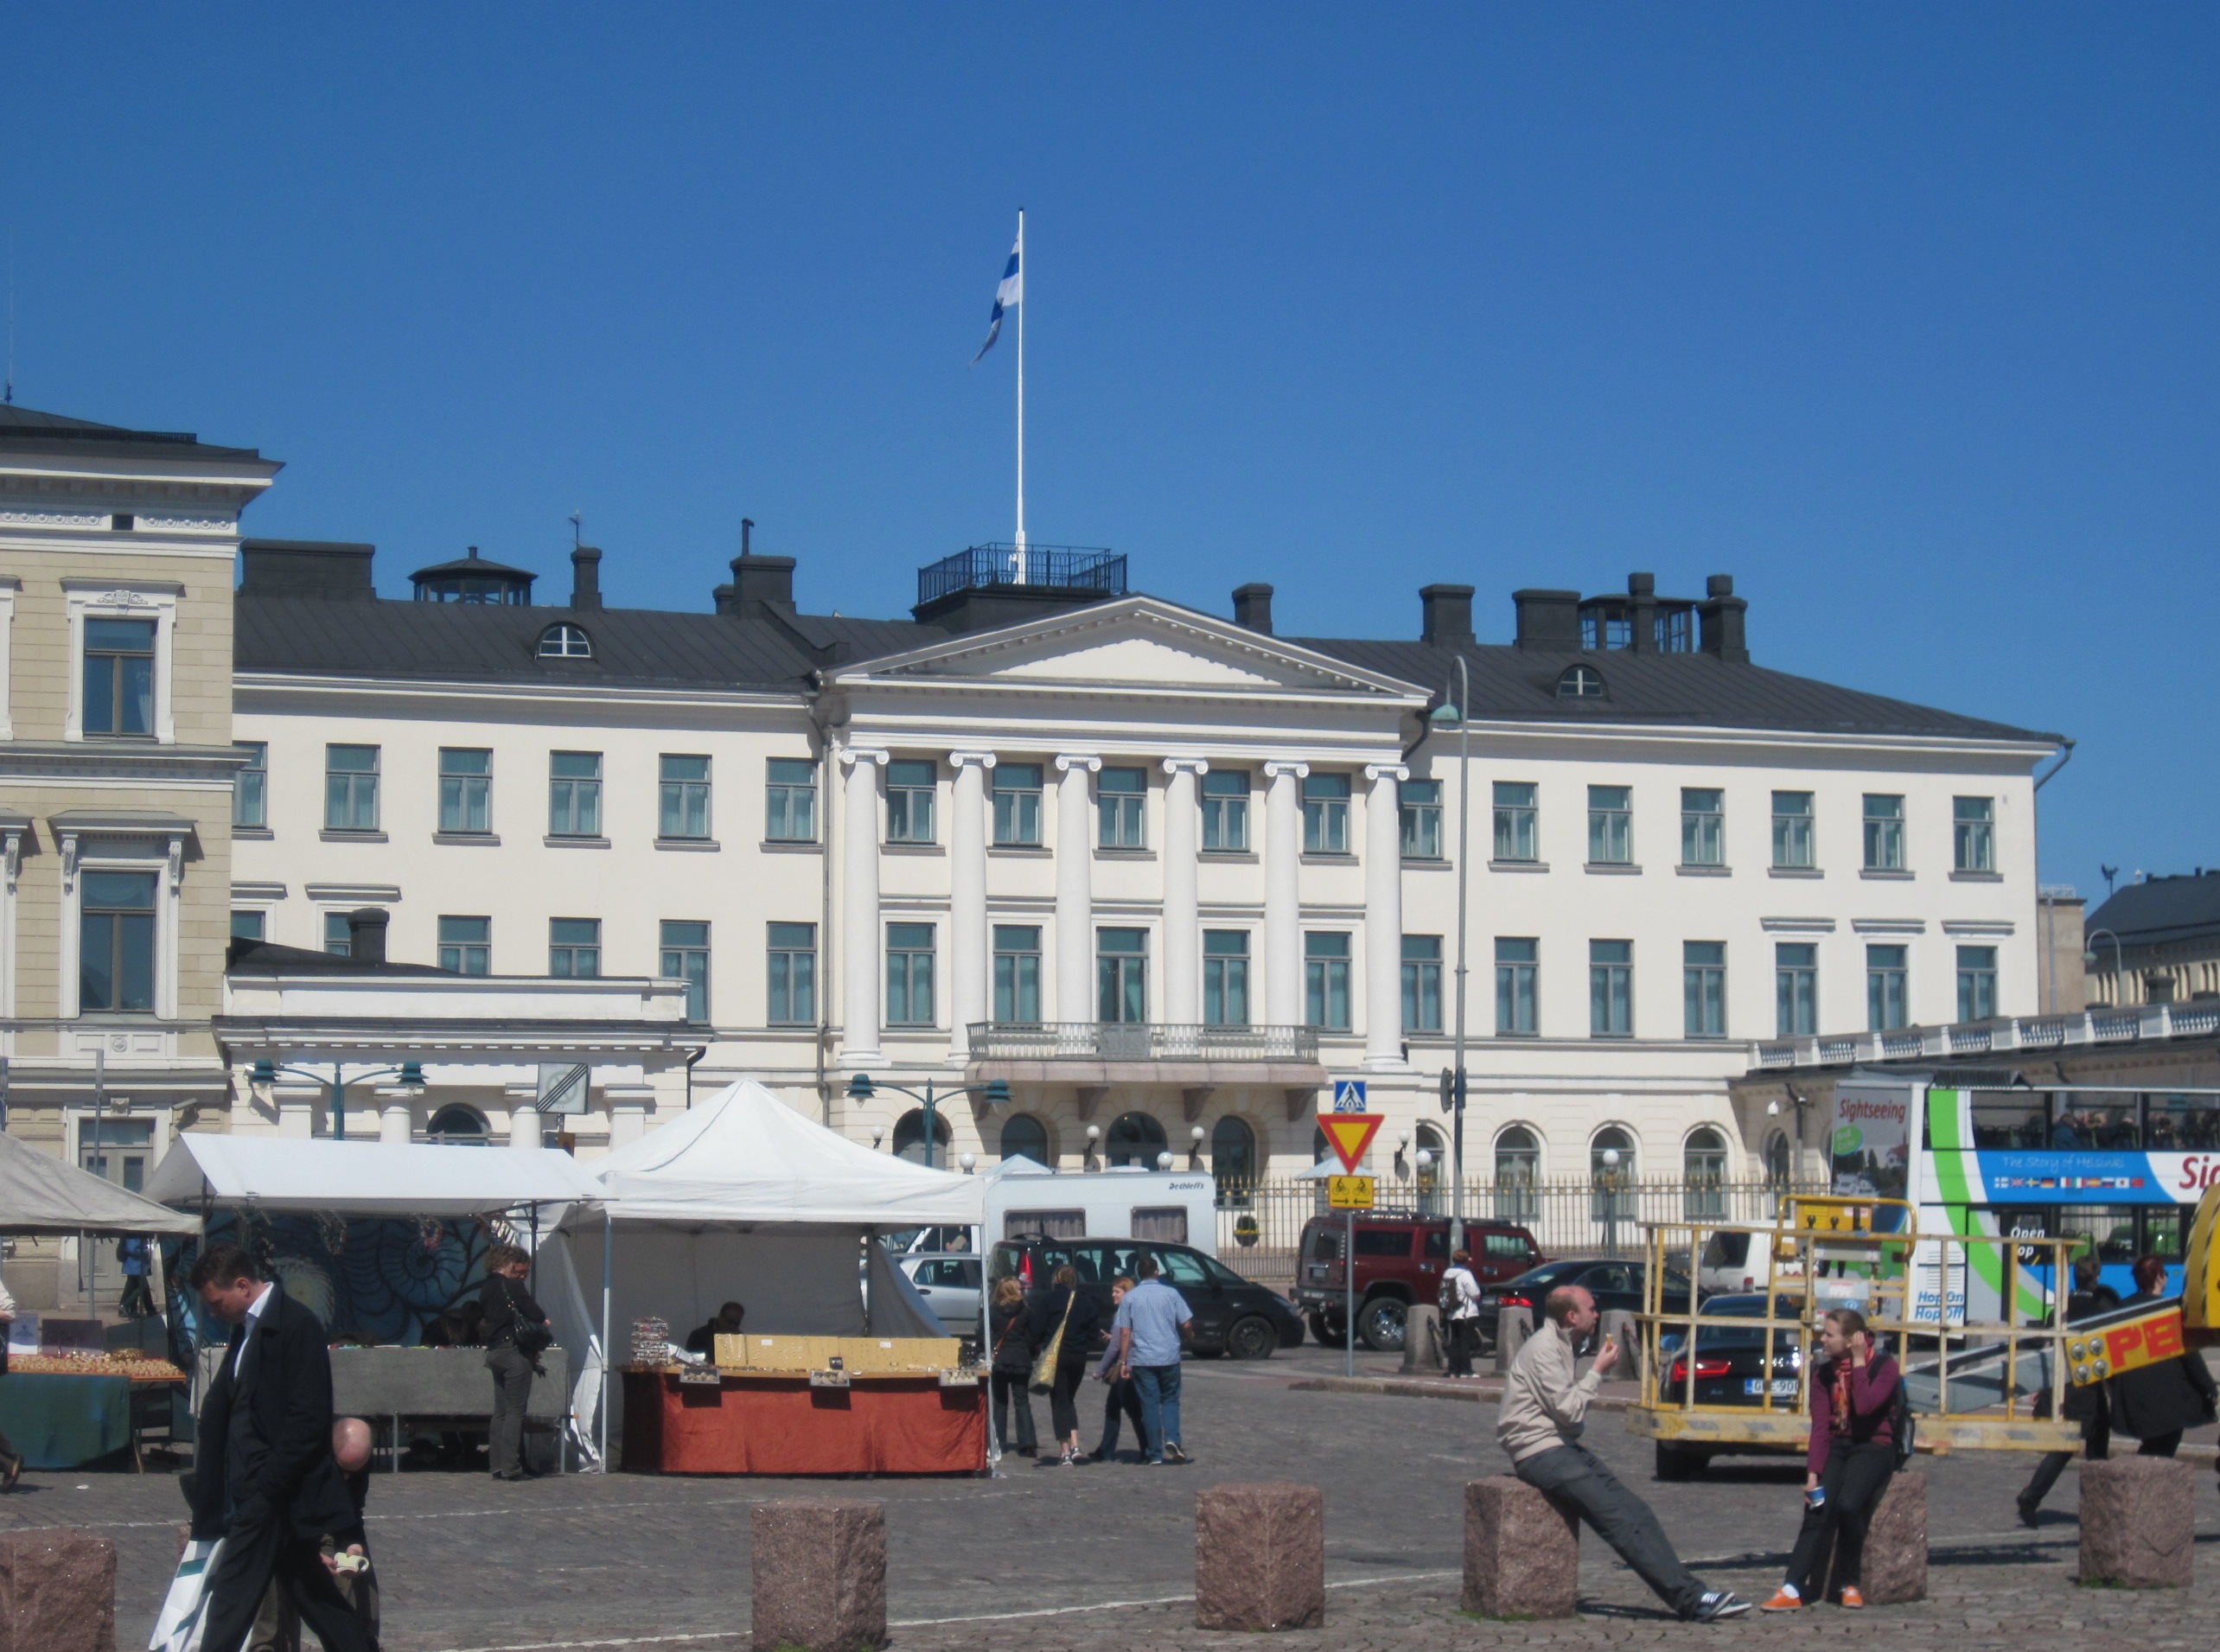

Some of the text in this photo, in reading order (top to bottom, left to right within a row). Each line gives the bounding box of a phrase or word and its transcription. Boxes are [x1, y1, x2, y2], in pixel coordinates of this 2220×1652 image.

[1839, 1098, 1906, 1124] Sightseeing
[2002, 1153, 2125, 1174] The Story of Helsinki
[2011, 1226, 2045, 1239] Open
[2017, 1246, 2034, 1260] op
[1946, 1291, 1964, 1302] On
[1916, 1305, 1942, 1321] Hop
[2106, 1312, 2183, 1368] PE
